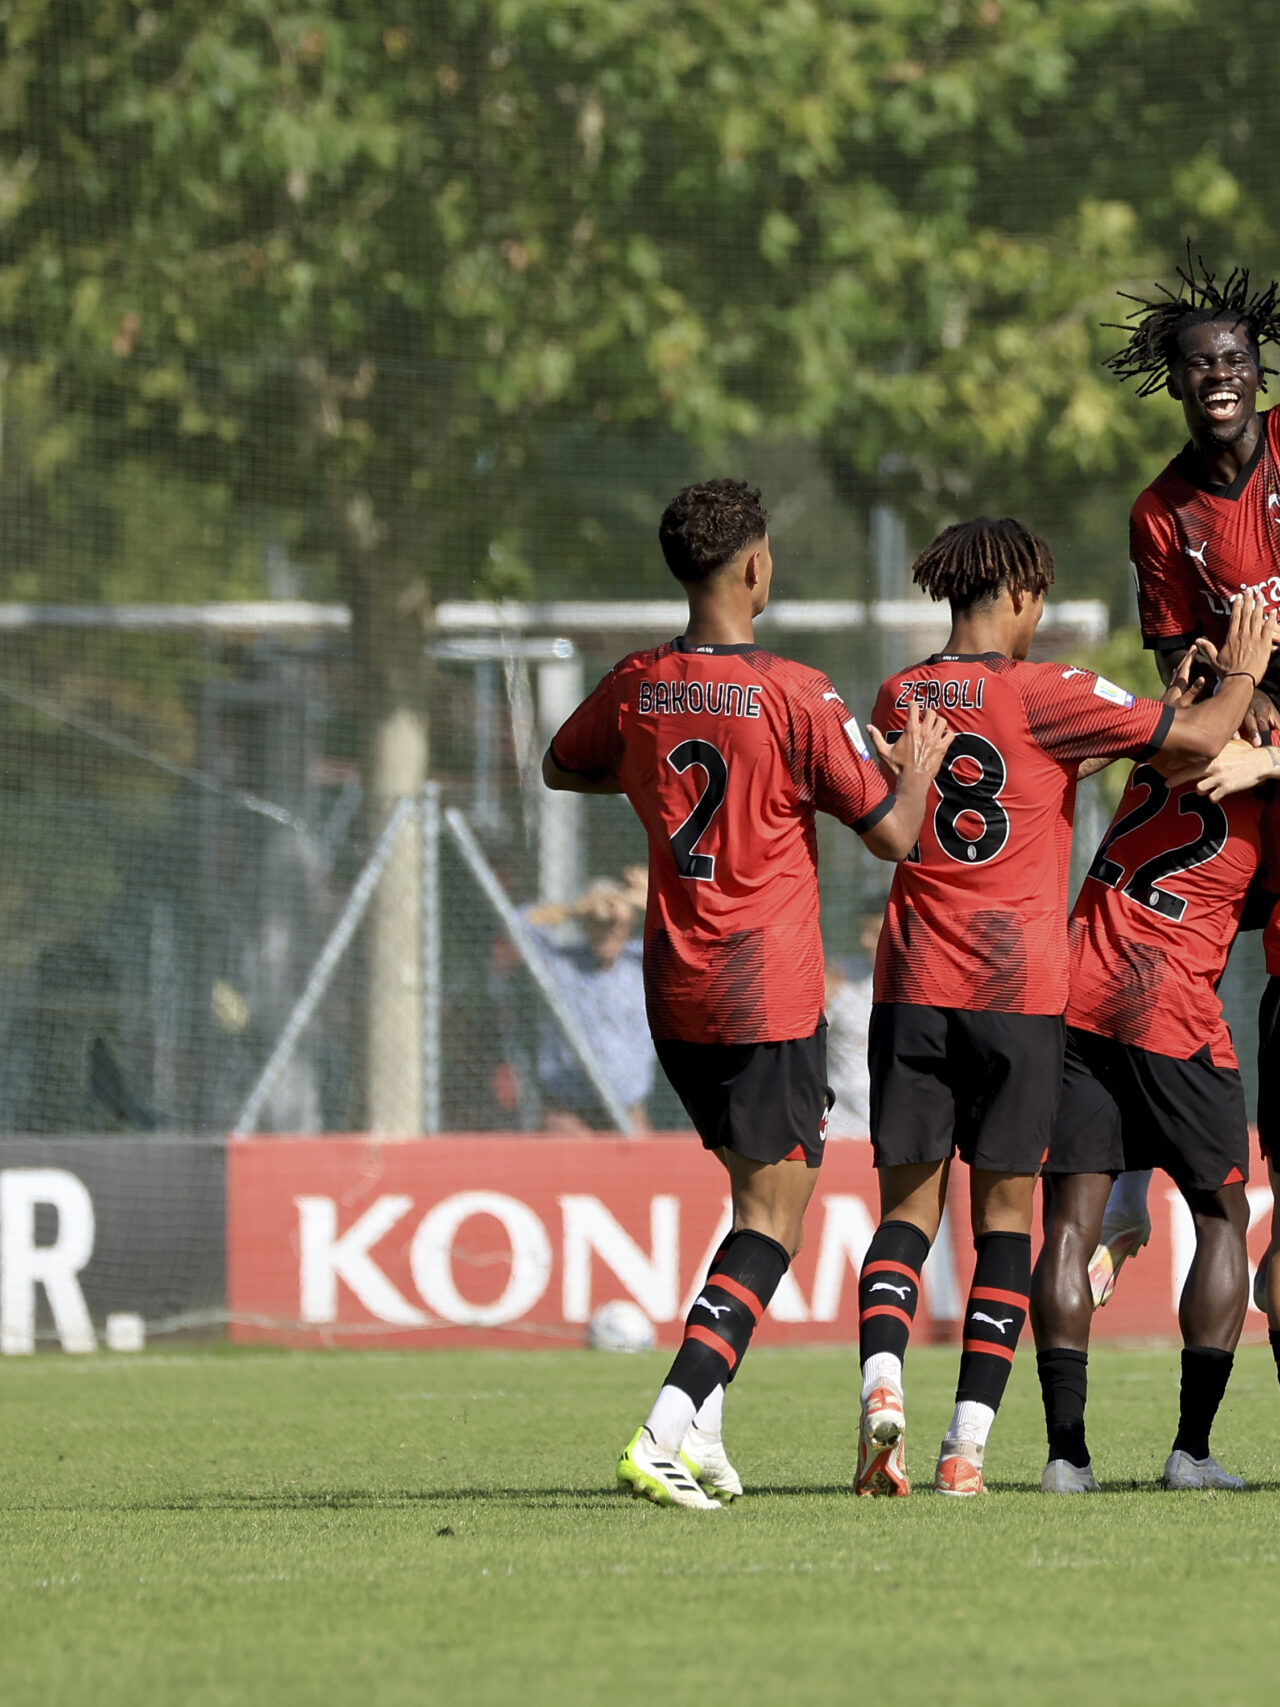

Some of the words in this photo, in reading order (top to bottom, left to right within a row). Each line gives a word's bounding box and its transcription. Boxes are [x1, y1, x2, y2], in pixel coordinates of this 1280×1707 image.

[639, 680, 762, 718] BAKOUNE
[895, 677, 985, 710] ZEROLI
[666, 738, 729, 882] 2
[885, 730, 1010, 866] 8
[1086, 763, 1229, 923] 22
[292, 1189, 965, 1327] KONM
